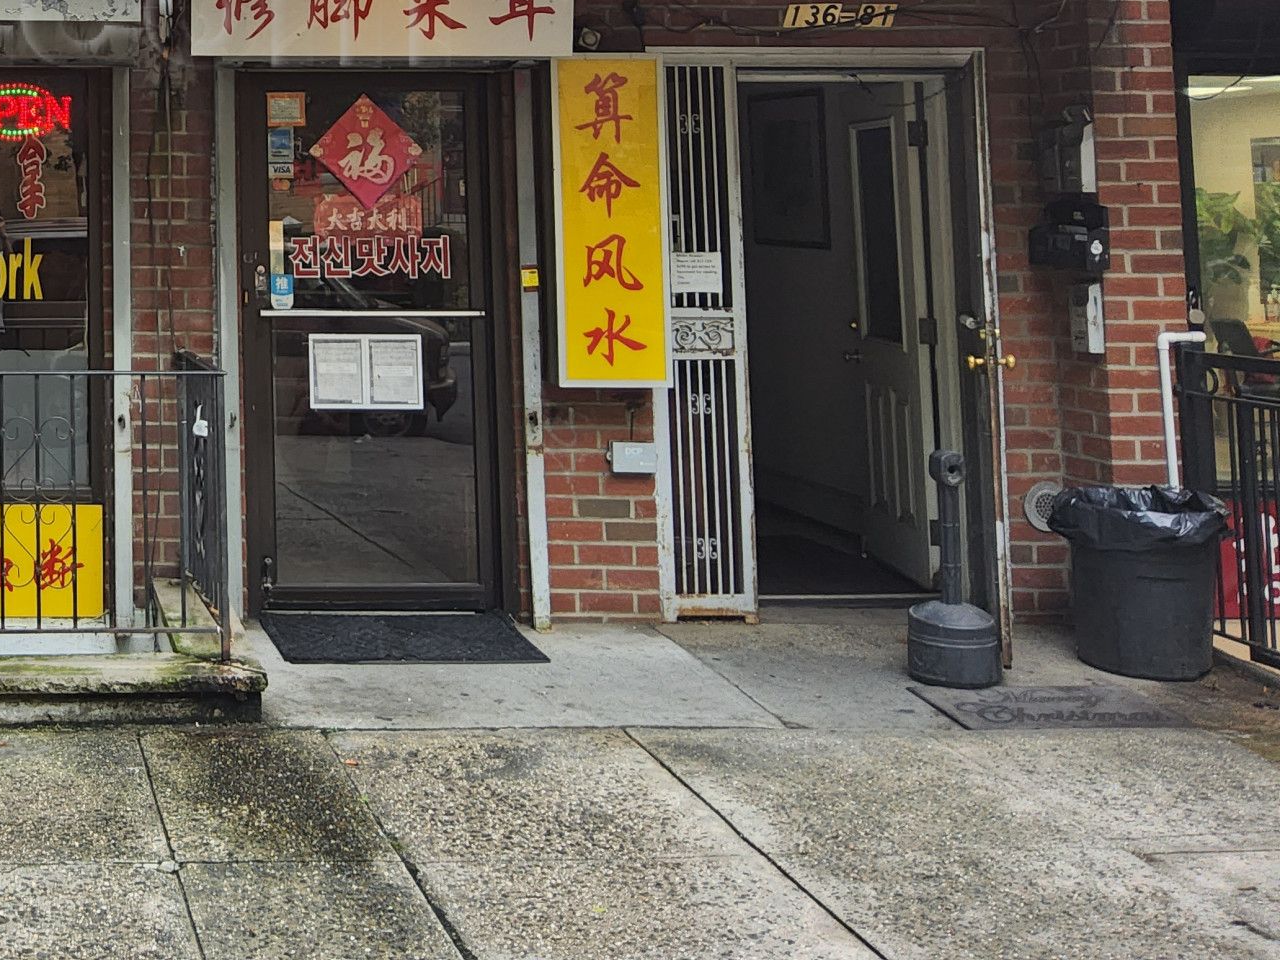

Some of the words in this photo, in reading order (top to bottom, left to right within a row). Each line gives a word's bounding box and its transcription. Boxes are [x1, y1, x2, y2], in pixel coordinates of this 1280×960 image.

[272, 165, 291, 174] VISA
[574, 71, 648, 368] 算命风水
